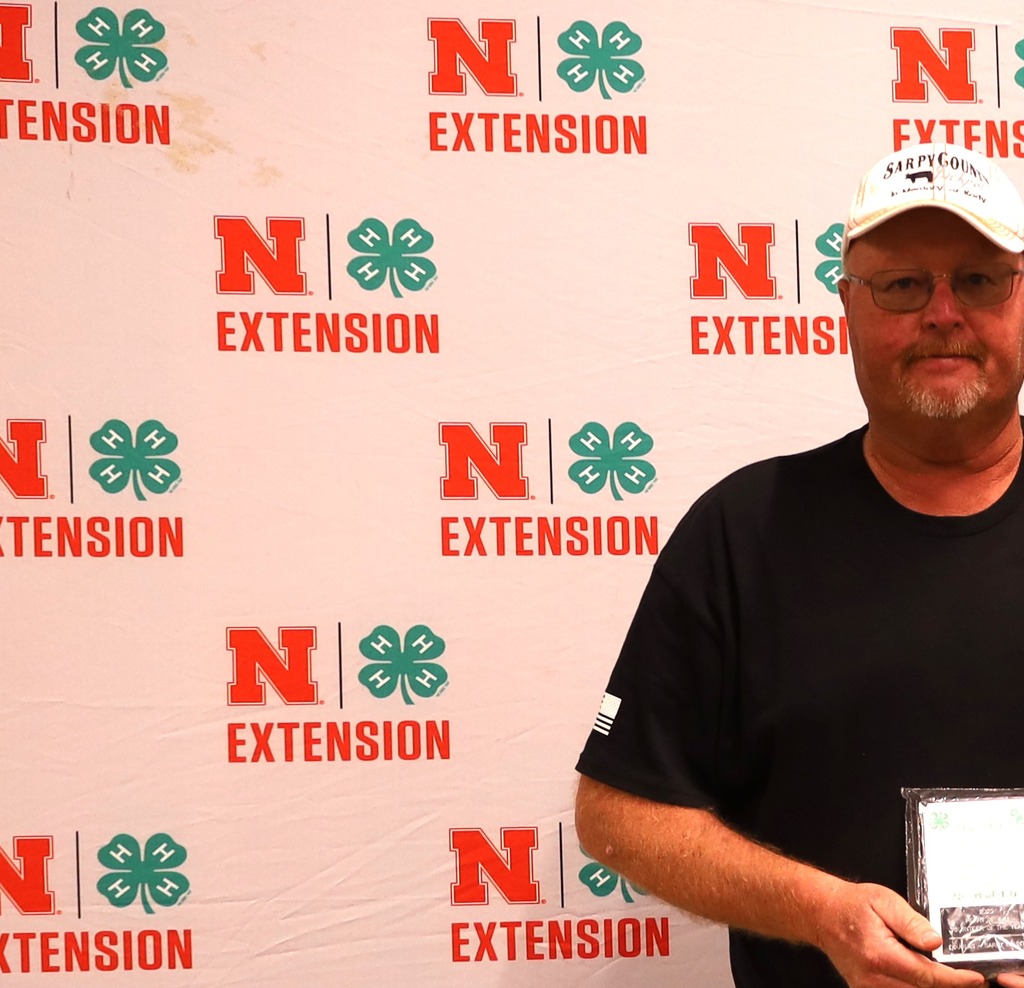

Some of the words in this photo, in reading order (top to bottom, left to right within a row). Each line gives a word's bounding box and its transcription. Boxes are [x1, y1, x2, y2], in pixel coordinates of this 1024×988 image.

[427, 17, 518, 97] N
[890, 27, 977, 104] N
[0, 99, 170, 144] TENSION
[429, 112, 647, 155] EXTENSION
[883, 154, 935, 179] SARPY
[213, 215, 306, 296] N
[688, 222, 777, 300] N
[216, 311, 440, 354] EXTENSION
[690, 316, 849, 355] EXTENSI
[438, 422, 529, 500] N
[0, 517, 183, 557] TENSION
[441, 515, 659, 557] EXTENSION
[226, 626, 319, 706] N
[227, 720, 451, 763] EXTENSION
[449, 826, 541, 906] N
[0, 930, 192, 973] TENSION
[451, 917, 670, 963] EXTENSION
